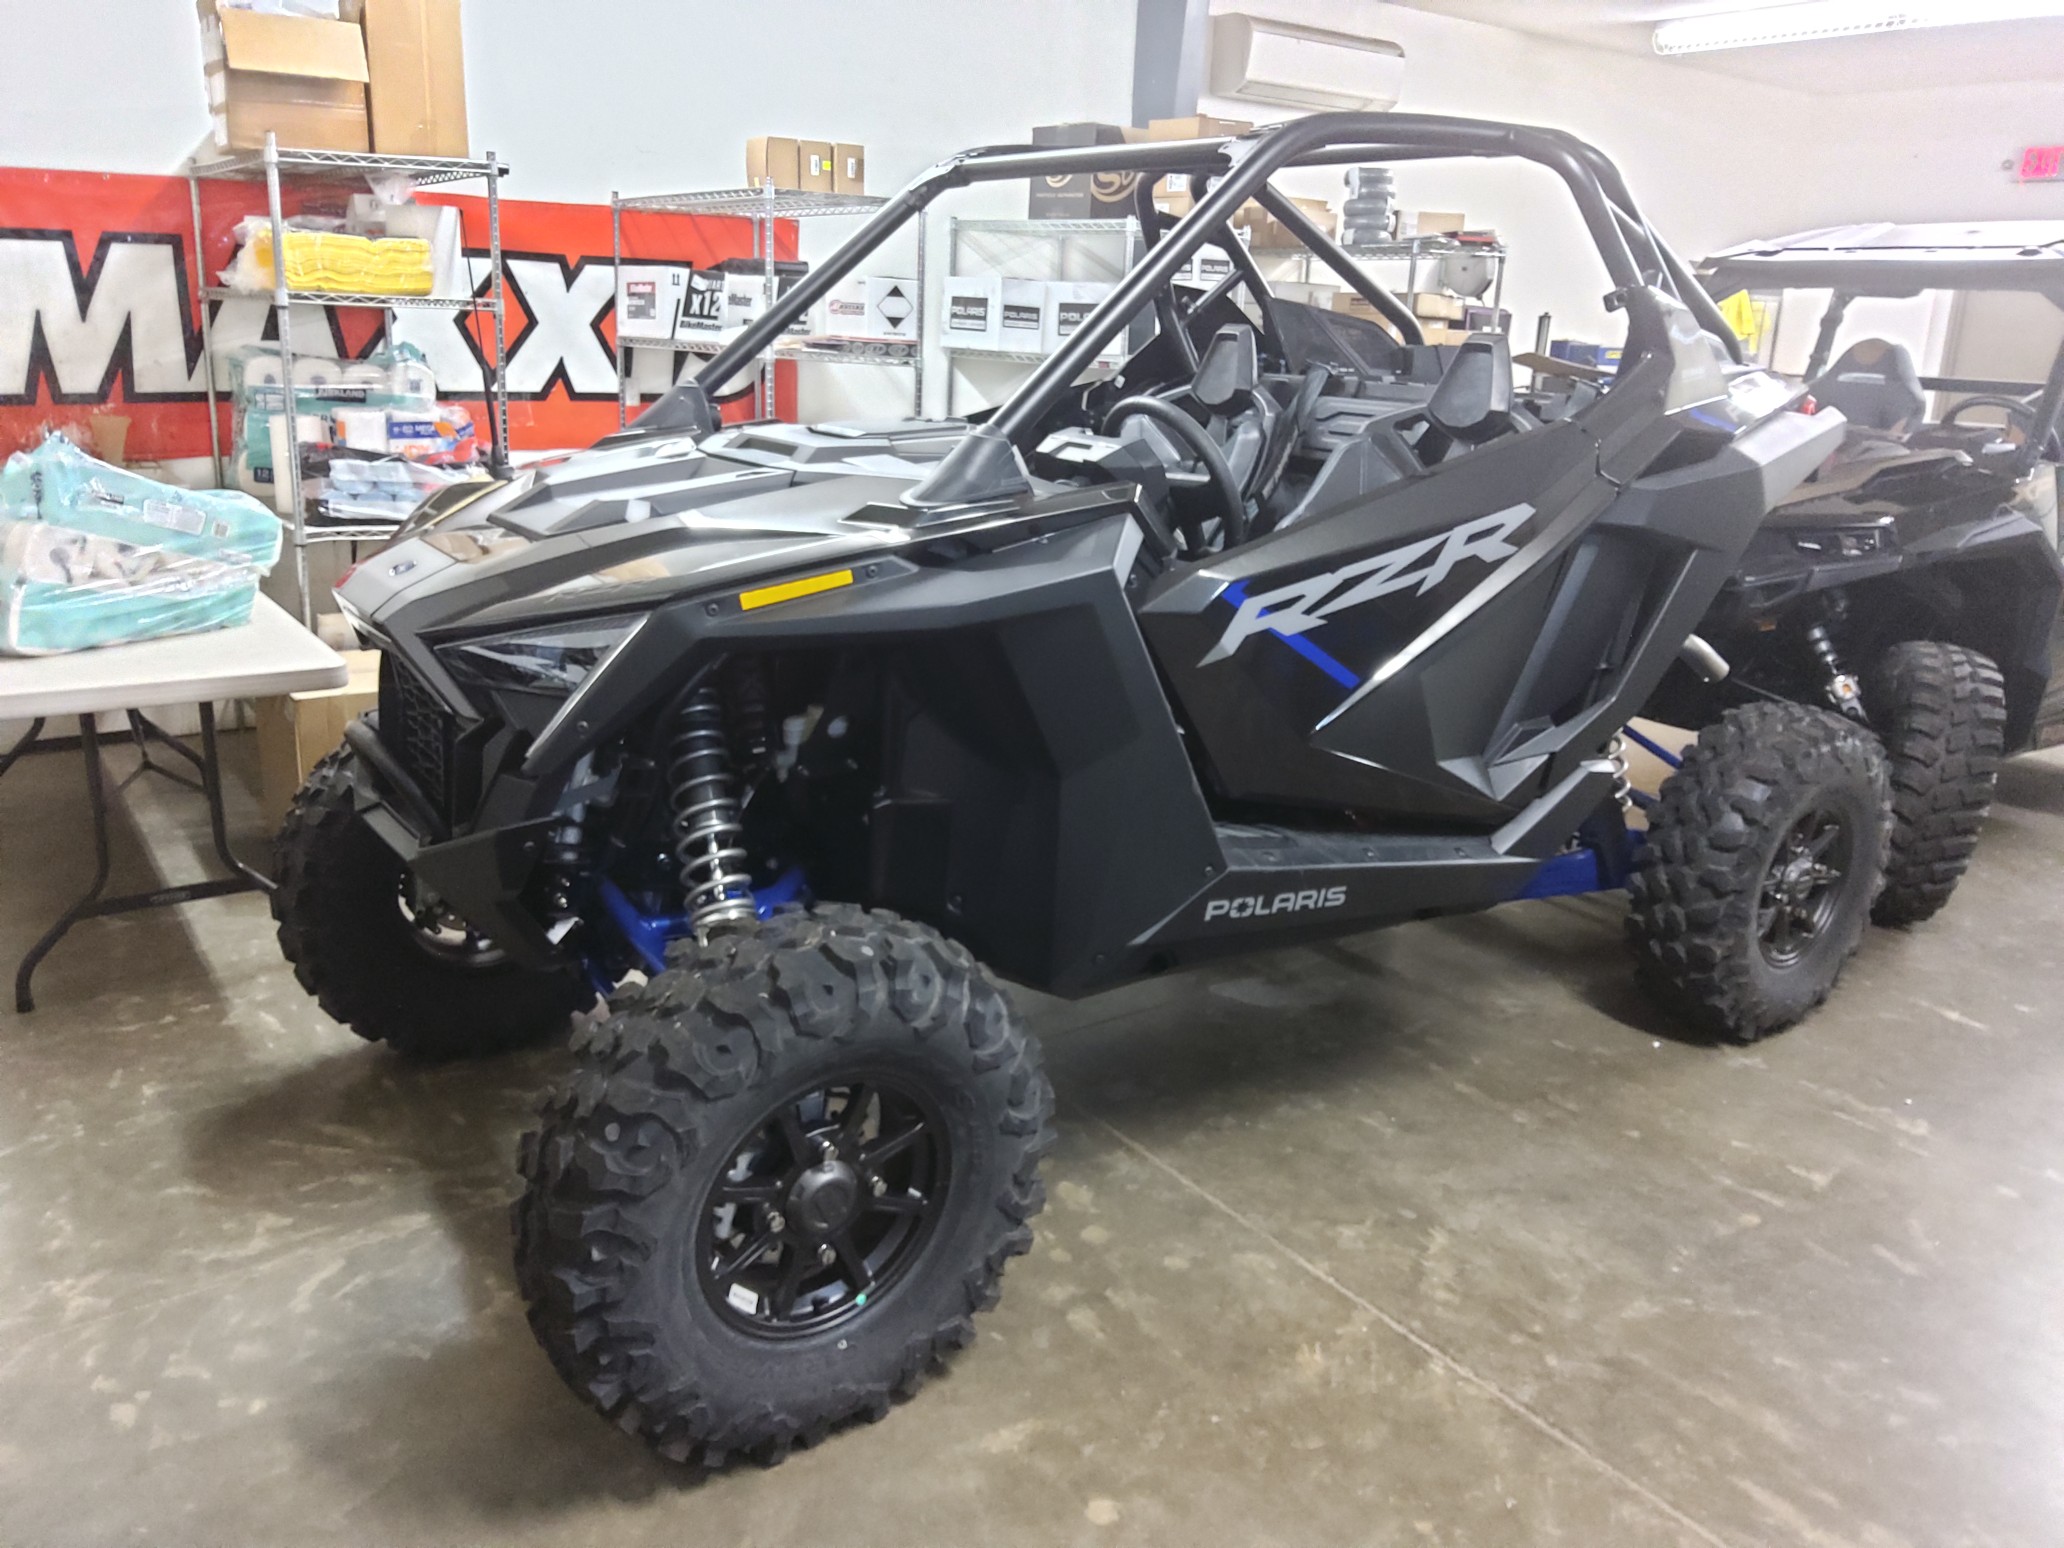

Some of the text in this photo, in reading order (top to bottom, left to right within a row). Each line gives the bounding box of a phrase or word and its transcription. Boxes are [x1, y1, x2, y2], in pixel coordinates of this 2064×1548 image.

[951, 305, 986, 317] POLARIS
[1004, 311, 1038, 320] POLARIS
[1196, 502, 1536, 668] RZR
[1204, 886, 1347, 922] POLARIS
